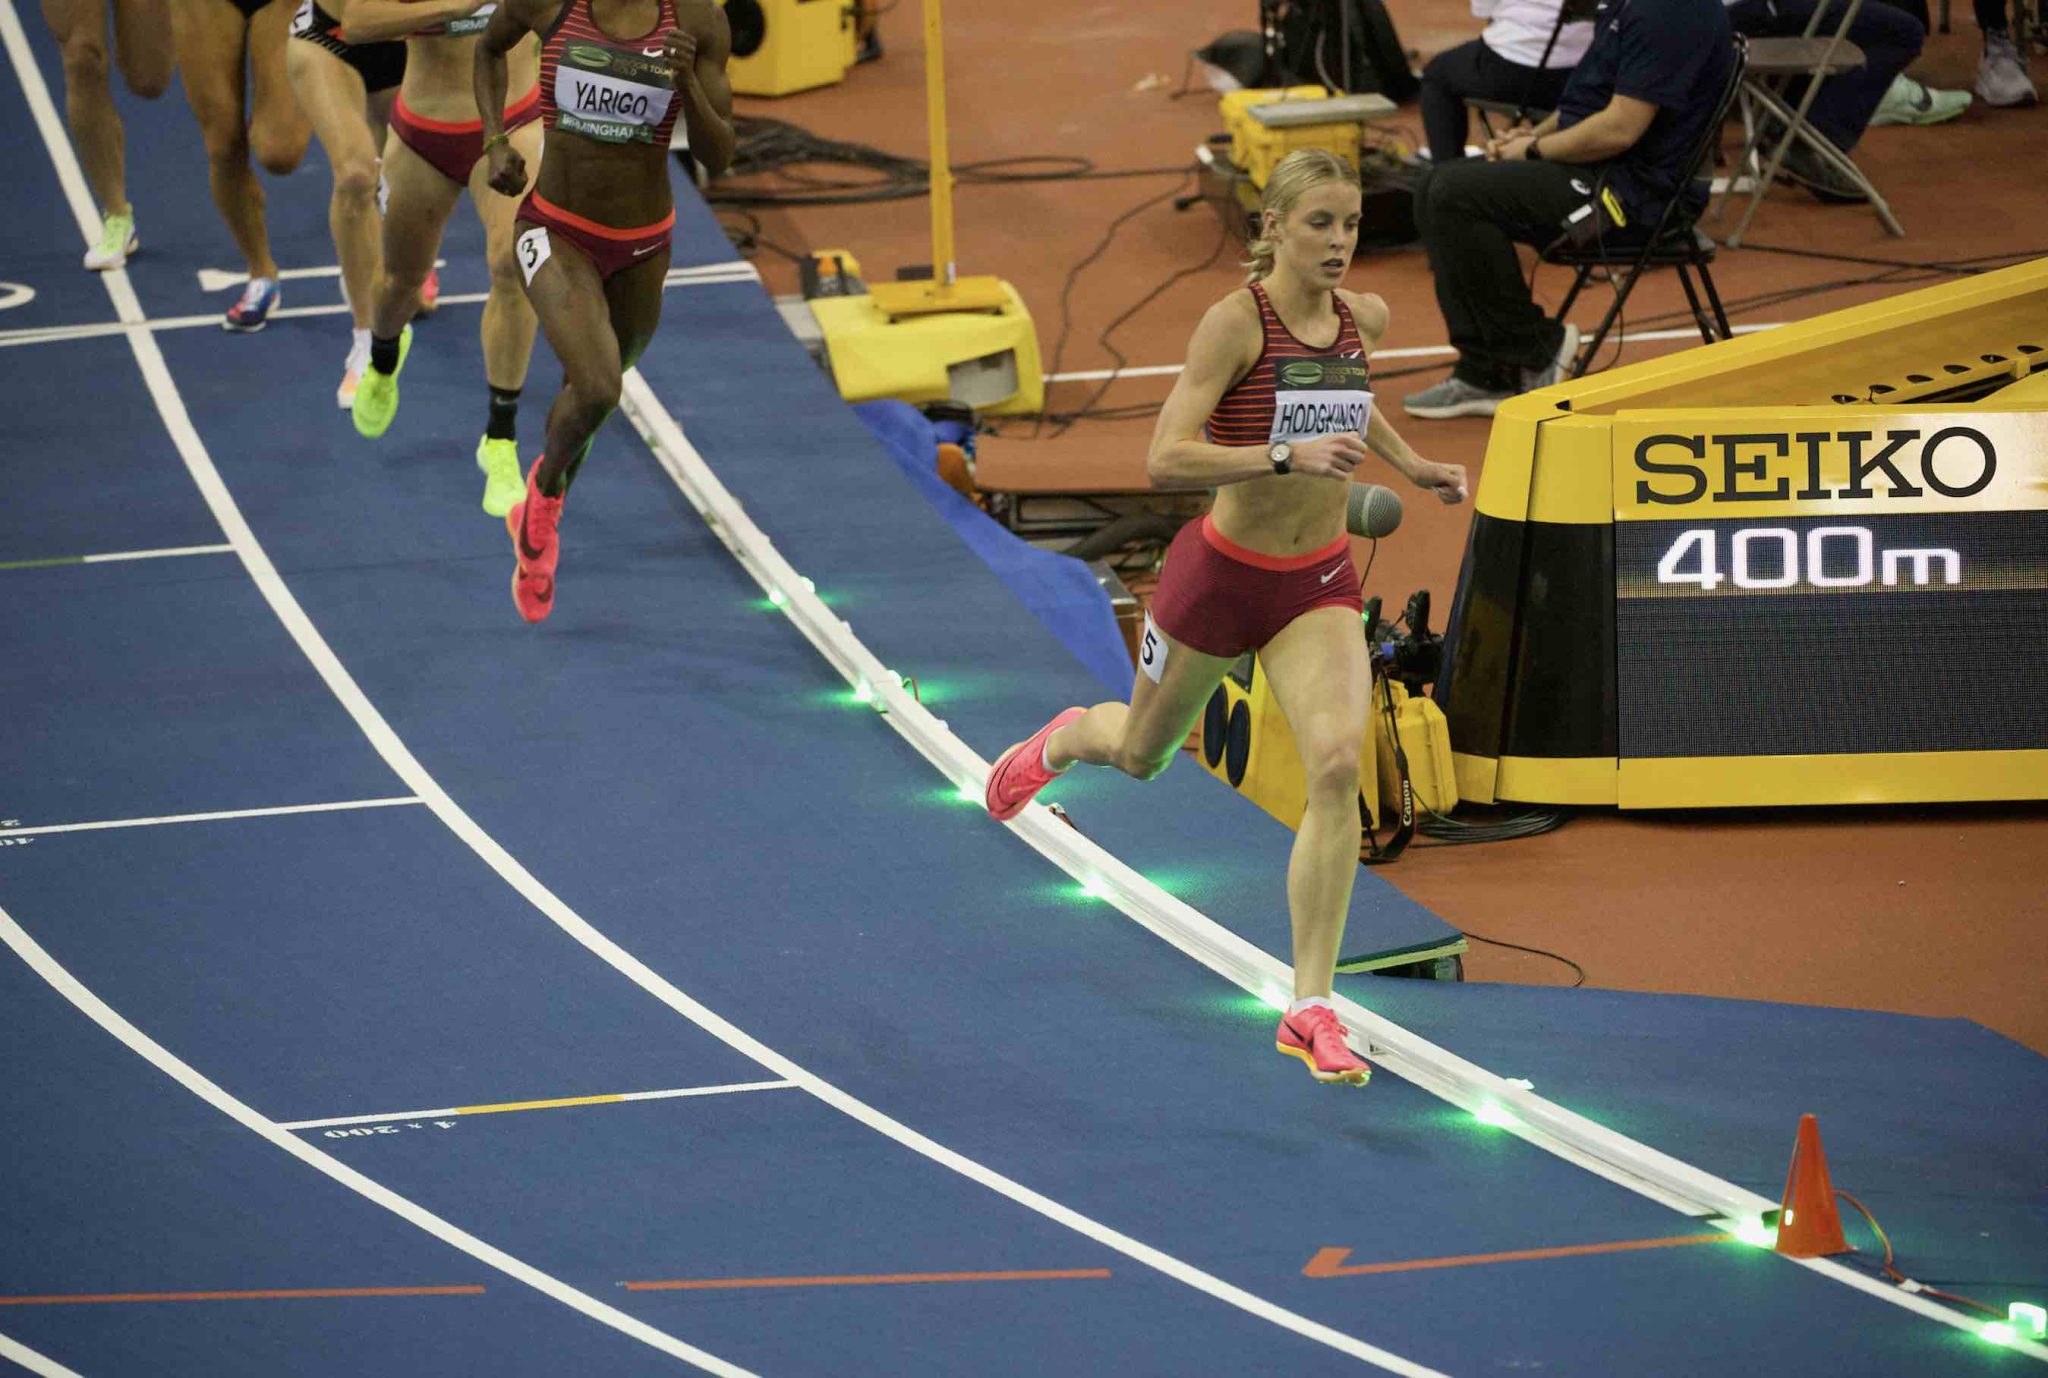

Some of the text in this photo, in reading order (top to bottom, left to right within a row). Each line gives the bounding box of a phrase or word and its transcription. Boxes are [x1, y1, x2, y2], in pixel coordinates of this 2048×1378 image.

[576, 81, 648, 116] YARIGO
[522, 238, 538, 268] 3
[1634, 426, 1997, 505] SEIKO
[1657, 526, 1961, 590] 400m
[1142, 629, 1157, 666] 5
[1402, 779, 1412, 827] Canon
[323, 1125, 400, 1138] 200
